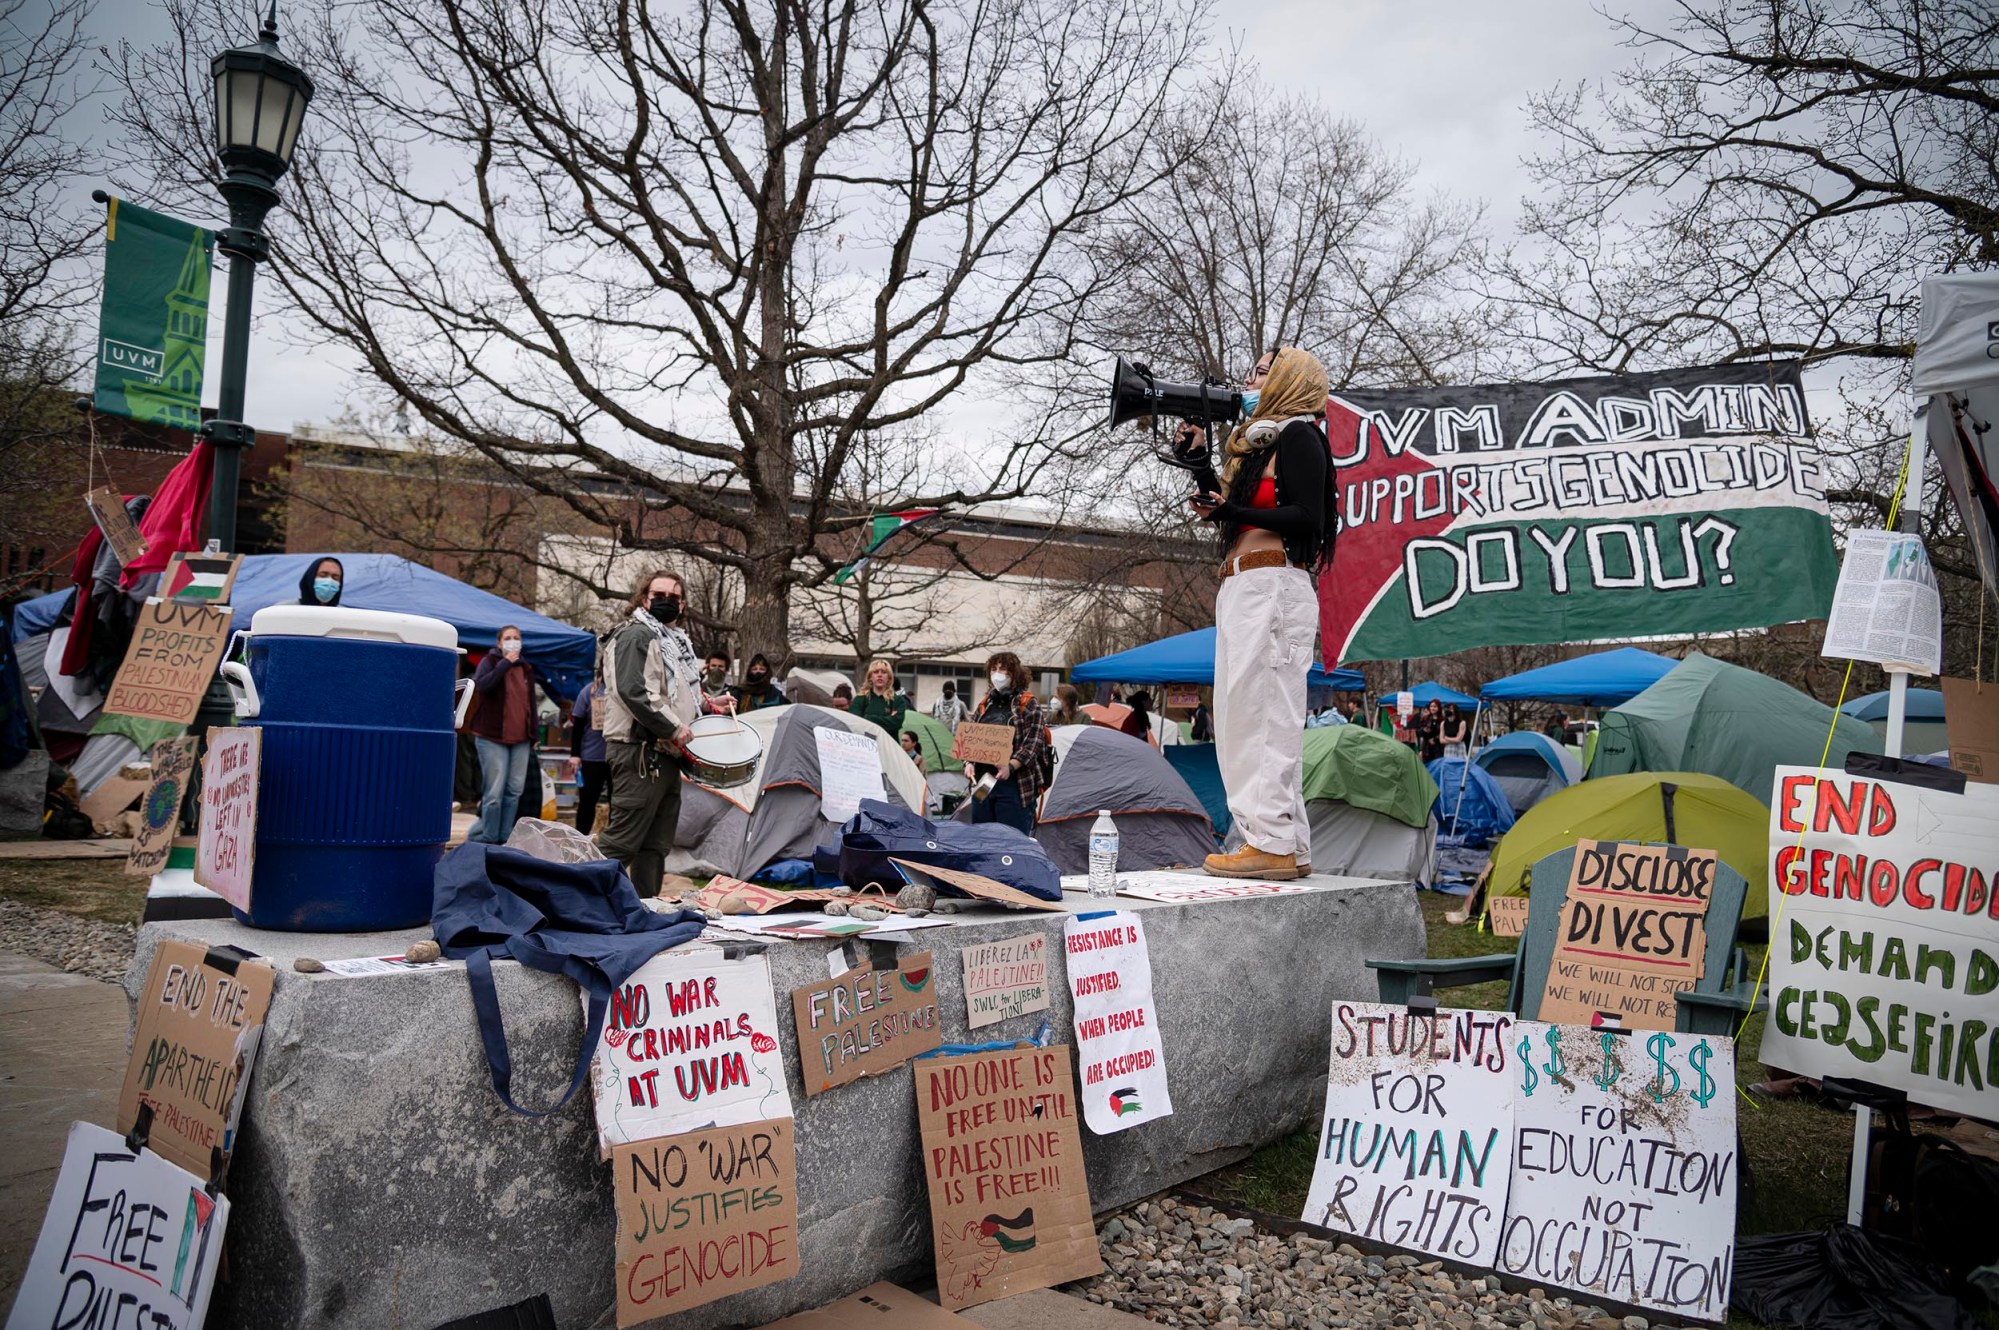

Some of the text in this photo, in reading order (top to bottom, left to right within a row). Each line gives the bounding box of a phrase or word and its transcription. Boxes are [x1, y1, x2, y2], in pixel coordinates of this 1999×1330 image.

[112, 347, 156, 369] UVM
[1319, 383, 1807, 470] UVM ADMIN
[1334, 442, 1828, 536] UPPORTS GENOCIDE
[1403, 513, 1740, 621] DO YOU?
[154, 602, 225, 633] UVM
[134, 647, 204, 671] FROM
[111, 688, 194, 718] BLOODSHED
[157, 740, 174, 758] THE
[220, 743, 238, 779] THERE
[212, 787, 221, 807] NO
[215, 802, 241, 831] LEFT IN
[1780, 775, 1896, 837] END
[215, 830, 238, 877] GAZA
[1577, 849, 1715, 899] DISCLOSE
[1493, 899, 1526, 911] FREE
[1016, 943, 1029, 961] LA
[1067, 925, 1137, 953] RESISTANCE IS
[1568, 901, 1702, 958] DIVEST
[161, 965, 249, 1031] END THE
[969, 963, 1044, 989] PALESTINE!!
[1076, 971, 1121, 997] JUSTIFIED.
[1548, 985, 1573, 1001] WE
[1579, 989, 1613, 1009] WILL
[1619, 995, 1653, 1015] NOT
[1557, 961, 1582, 978] WE
[1589, 967, 1622, 986] WILL
[1630, 974, 1661, 993] NOT
[610, 976, 720, 1030] NO WAR
[808, 970, 893, 1032] FREE
[1078, 1008, 1145, 1041] WHEN PEOPLE
[626, 1013, 752, 1063] CRIMINALS
[821, 1004, 935, 1075] PALESTINE
[1335, 1004, 1511, 1074] STUDENTS
[628, 1051, 750, 1109] AT UVM
[930, 1054, 1055, 1112] NO ONE IS
[1087, 1049, 1155, 1085] ARE OCCUPIED!
[946, 1094, 1072, 1137] FREE UNTIL
[1371, 1070, 1447, 1118] FOR
[1581, 1105, 1641, 1134] FOR
[631, 1126, 781, 1193] NO "WAR"
[932, 1131, 1061, 1179] PALESTINE
[1324, 1118, 1499, 1189] HUMAN
[1518, 1128, 1733, 1204] EDUCATION
[944, 1165, 1060, 1206] IS FREE!!!
[60, 1152, 168, 1274] FREE
[633, 1185, 783, 1243] JUSTIFIES
[1321, 1175, 1492, 1259] RIGHTS
[1583, 1196, 1653, 1232] NOT
[627, 1225, 790, 1305] GENOCIDE
[1503, 1216, 1730, 1313] OCCUPATION
